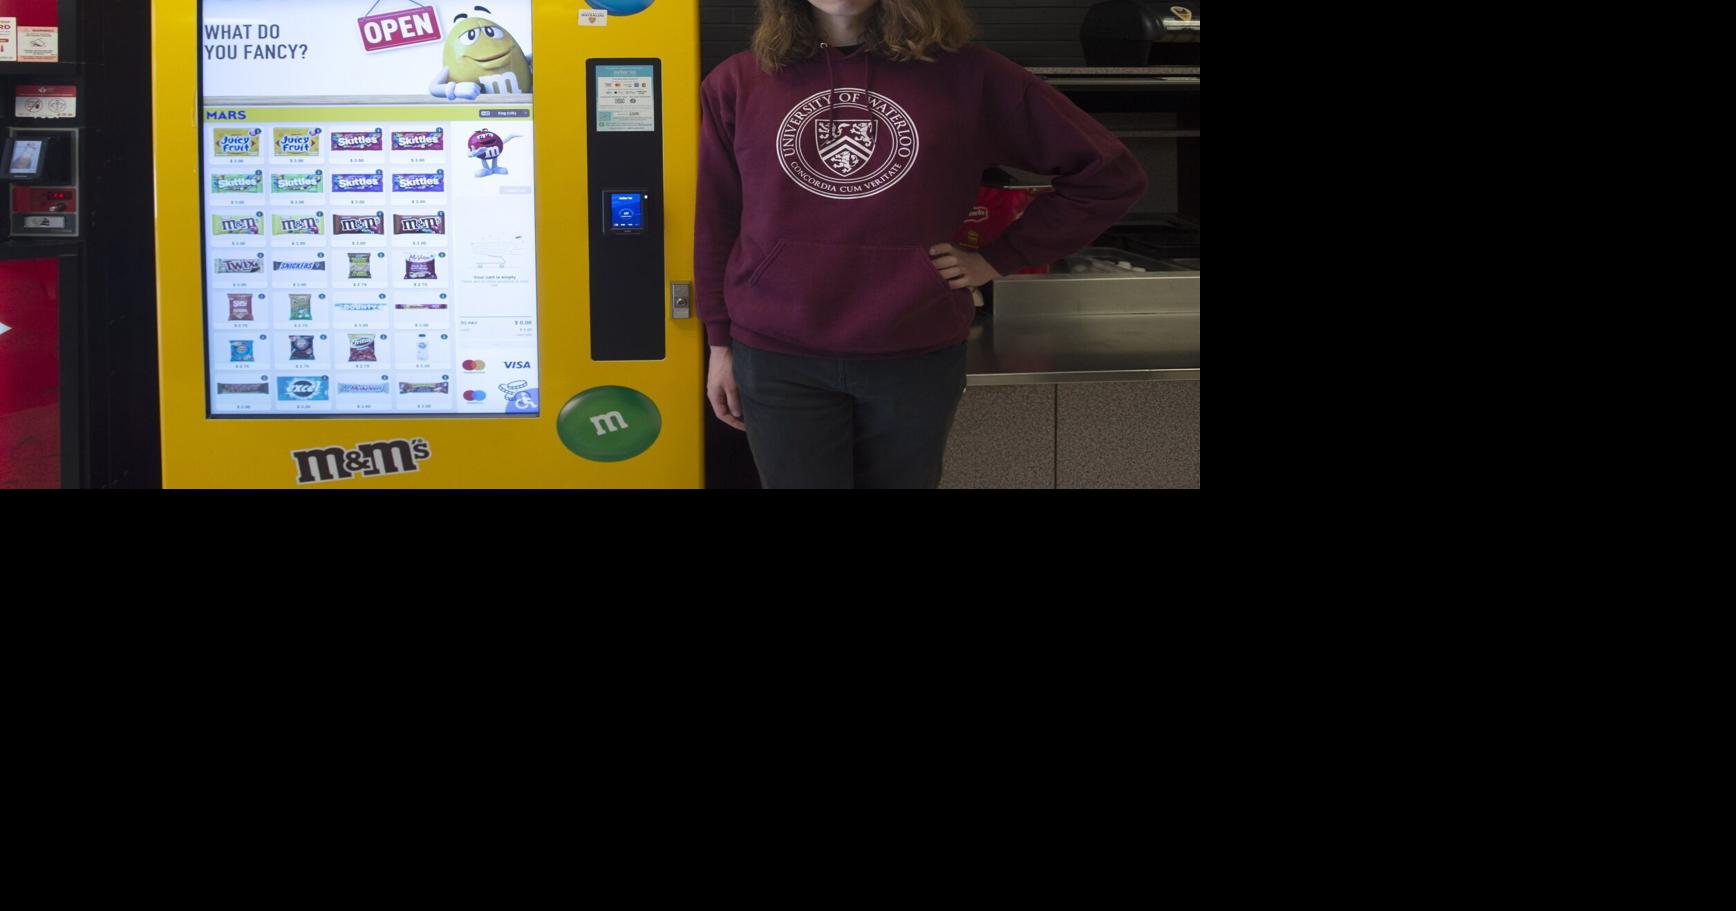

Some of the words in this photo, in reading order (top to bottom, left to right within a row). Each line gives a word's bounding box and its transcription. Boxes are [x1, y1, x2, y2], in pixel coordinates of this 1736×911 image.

[204, 24, 252, 39] WHAT
[258, 24, 280, 39] DO
[364, 12, 434, 44] OPEN
[204, 44, 237, 60] YOU
[244, 44, 308, 60] FANCY?
[206, 110, 246, 120] MARS
[782, 94, 832, 157] UNIVERSITY
[839, 93, 860, 102] OF
[868, 96, 912, 158] WATERLOO
[221, 136, 250, 144] Juicy
[281, 136, 310, 144] Juicy
[338, 136, 378, 146] Skittles
[398, 136, 439, 146] Skittles
[223, 144, 249, 152] Fruit
[283, 144, 310, 152] Fruit
[485, 146, 500, 159] m
[790, 161, 837, 192] CONCORDIA
[864, 163, 902, 190] VERITATE
[218, 178, 257, 188] Skittles
[278, 178, 317, 188] Skittles
[339, 178, 378, 188] Skittles
[399, 178, 439, 188] Skittles
[590, 411, 628, 436] m
